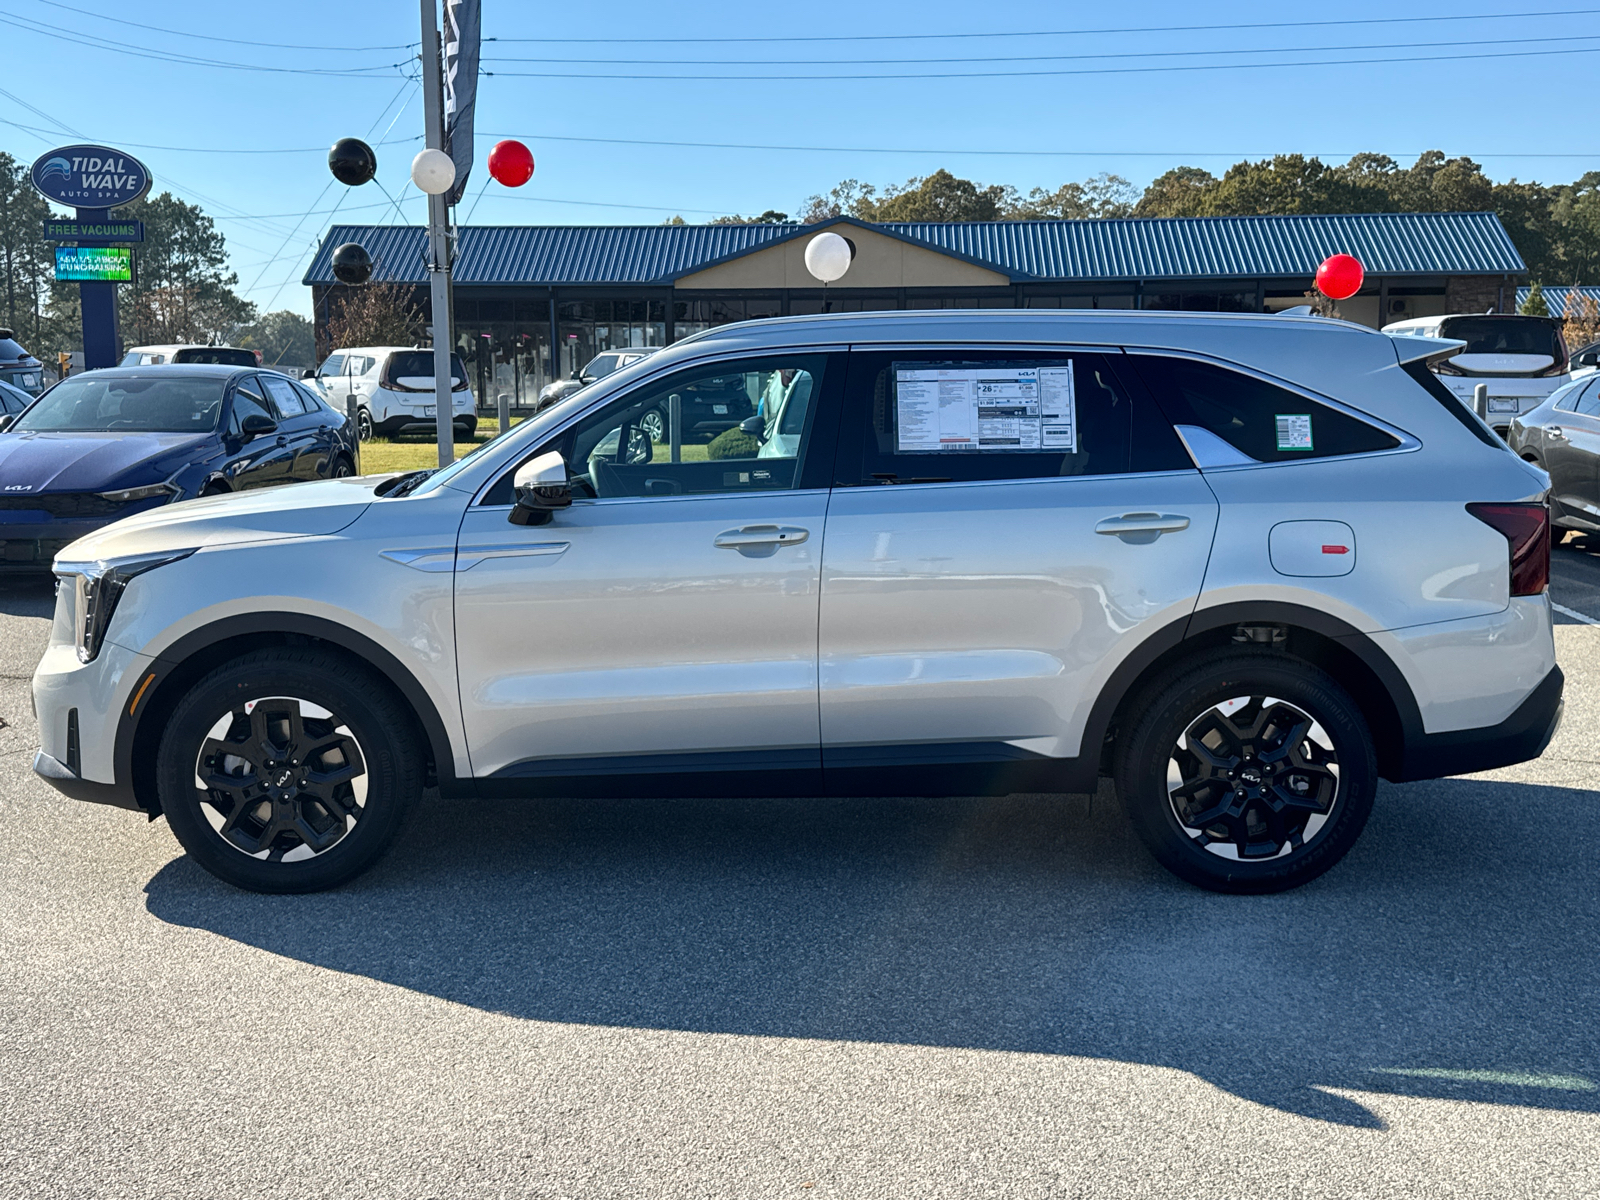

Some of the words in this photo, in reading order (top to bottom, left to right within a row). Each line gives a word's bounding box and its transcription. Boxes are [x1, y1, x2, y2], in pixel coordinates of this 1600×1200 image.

[72, 157, 126, 173] TIDAL
[82, 174, 137, 190] WAVE
[60, 190, 89, 198] AUTO
[98, 191, 120, 199] SPA
[48, 224, 78, 235] FREE
[81, 224, 135, 236] VACUUMS
[60, 263, 126, 272] FUNDRAISING
[982, 385, 993, 394] 26
[276, 770, 291, 787] KIA
[1241, 773, 1261, 783] KIA
